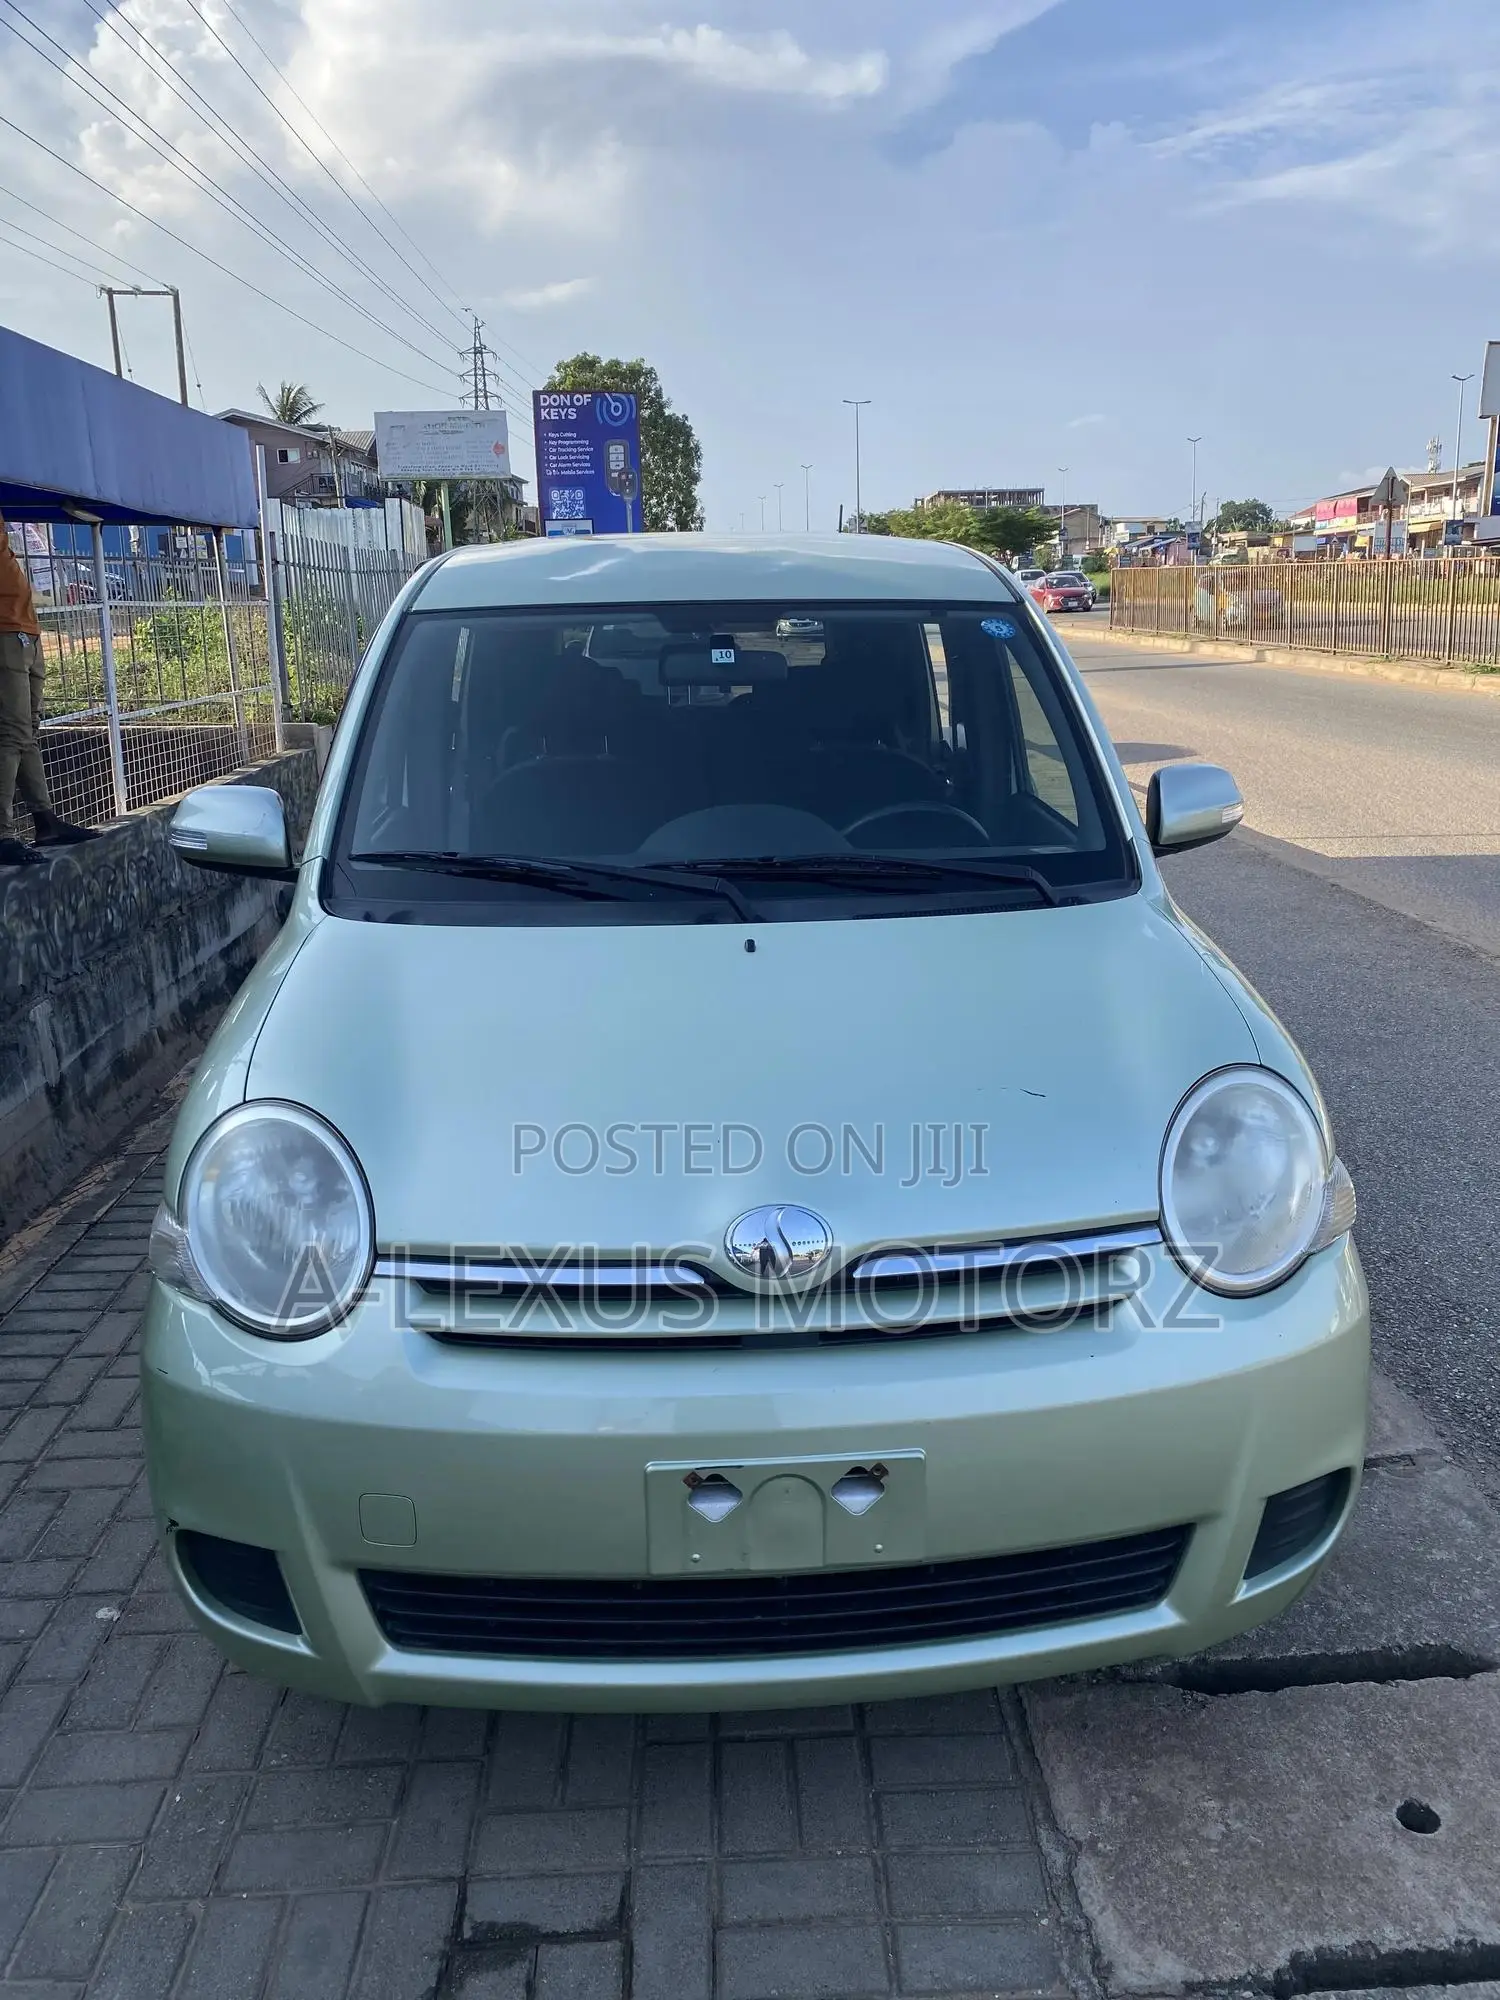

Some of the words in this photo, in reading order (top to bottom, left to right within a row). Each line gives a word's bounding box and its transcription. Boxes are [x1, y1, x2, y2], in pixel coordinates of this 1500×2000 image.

[540, 394, 570, 406] DON
[573, 394, 592, 406] OF
[541, 407, 577, 420] KEYS
[719, 650, 732, 659] 10
